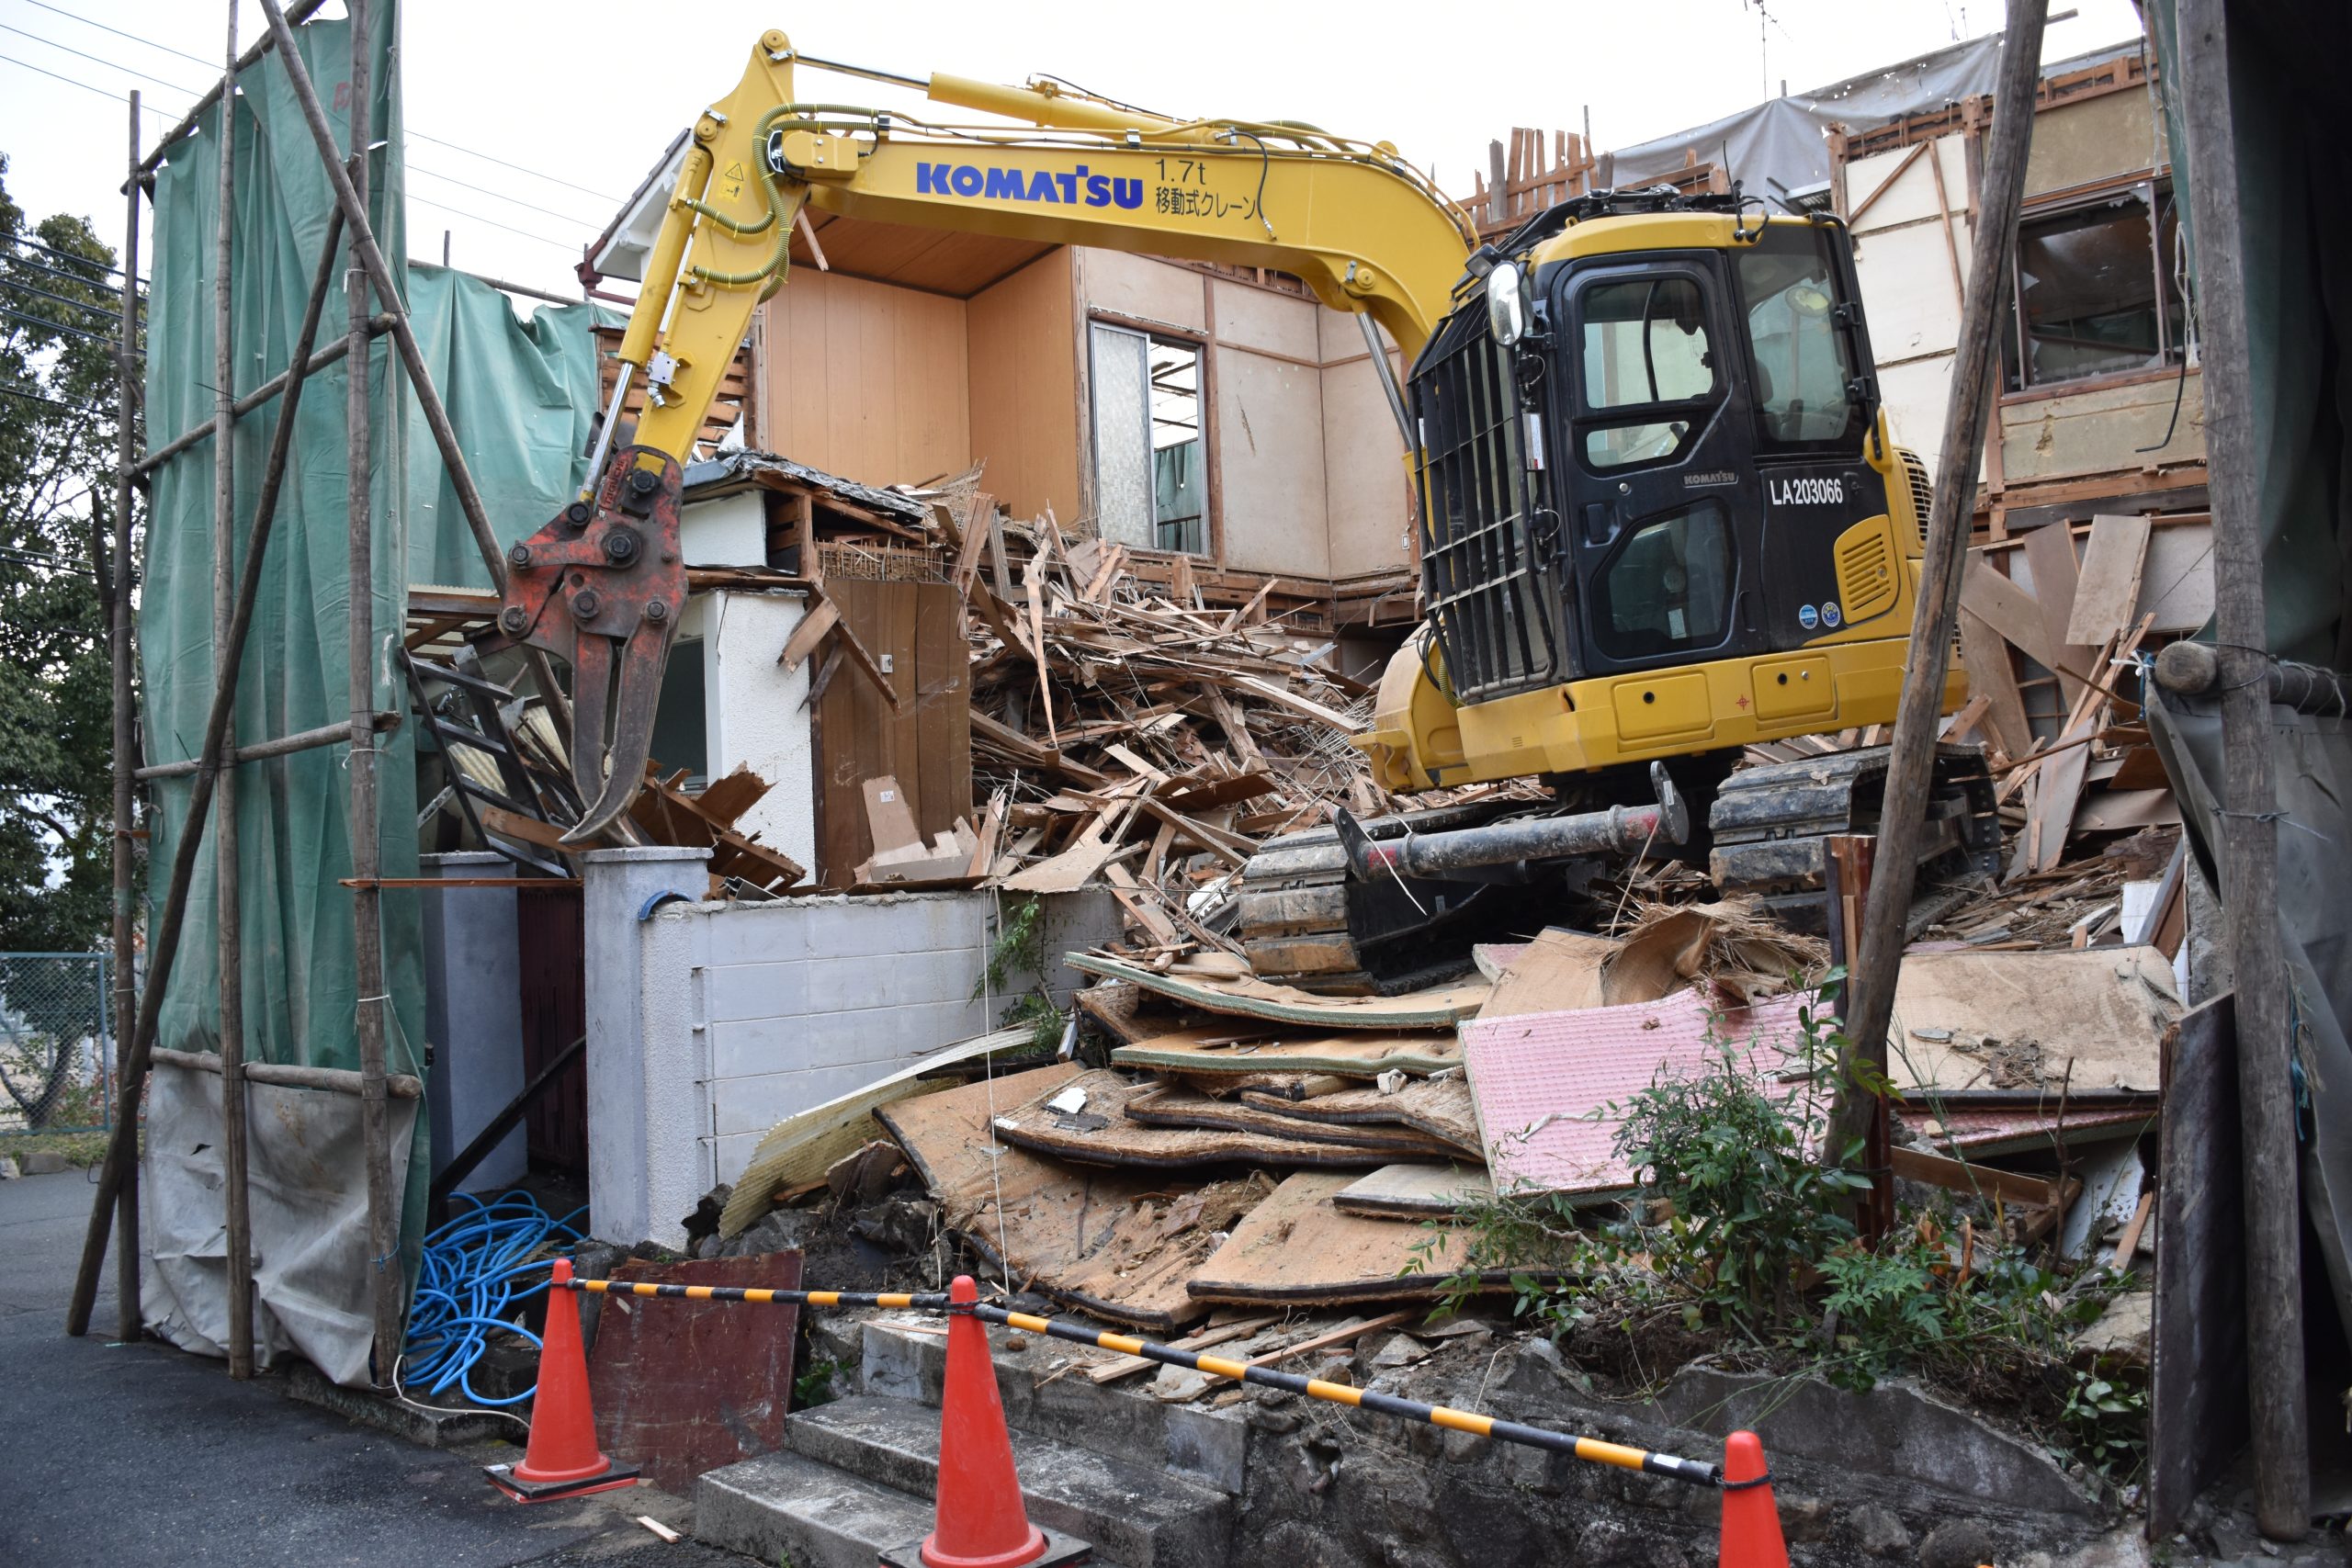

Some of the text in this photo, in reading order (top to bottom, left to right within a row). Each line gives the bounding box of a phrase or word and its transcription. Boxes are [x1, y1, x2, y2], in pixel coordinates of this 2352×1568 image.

[916, 162, 1144, 209] KOMATSU
[1155, 158, 1206, 186] 1.7t
[1156, 186, 1256, 220] 移動式クレーン
[1683, 470, 1735, 485] KOMATSU
[1770, 479, 1843, 505] LA203066
